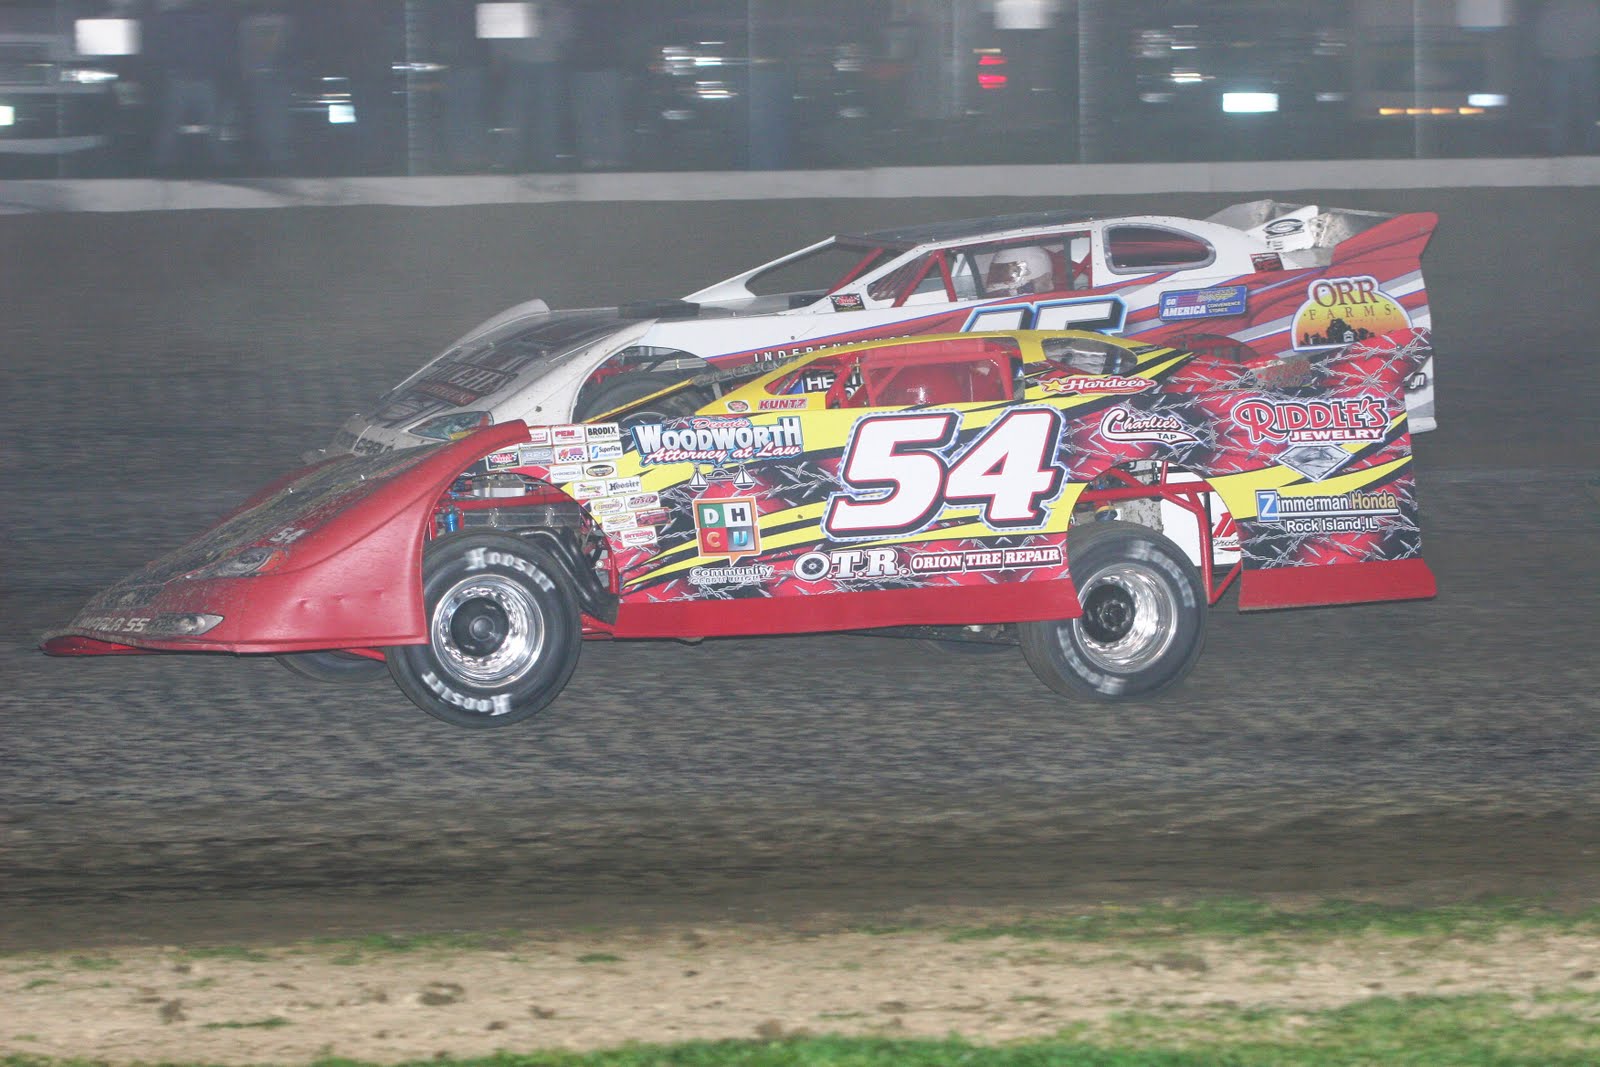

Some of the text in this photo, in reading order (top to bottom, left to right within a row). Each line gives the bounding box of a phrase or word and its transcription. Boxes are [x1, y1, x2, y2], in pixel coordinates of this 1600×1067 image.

[1313, 281, 1379, 307] ORR
[1162, 305, 1206, 317] AMERICA
[1308, 306, 1392, 320] FARMS
[1063, 379, 1148, 392] Hardee's
[759, 398, 806, 410] KUNTZ
[693, 417, 750, 429] Dennis
[1101, 408, 1181, 436] Charlie's
[1232, 398, 1387, 442] RIDDLE'S
[587, 426, 617, 436] BRODIX
[634, 416, 801, 451] WOODWORTH
[1156, 432, 1178, 441] TAP
[1290, 428, 1383, 441] JEWELRY
[645, 442, 801, 463] Attorney at Law
[824, 407, 1066, 539] 54
[1257, 490, 1397, 520] Zimmerman Honda
[703, 507, 747, 524] D H
[1287, 520, 1319, 533] Rock
[706, 530, 748, 548] C U
[913, 548, 1061, 570] ORION TIRE REPAIR
[690, 564, 775, 578] Community
